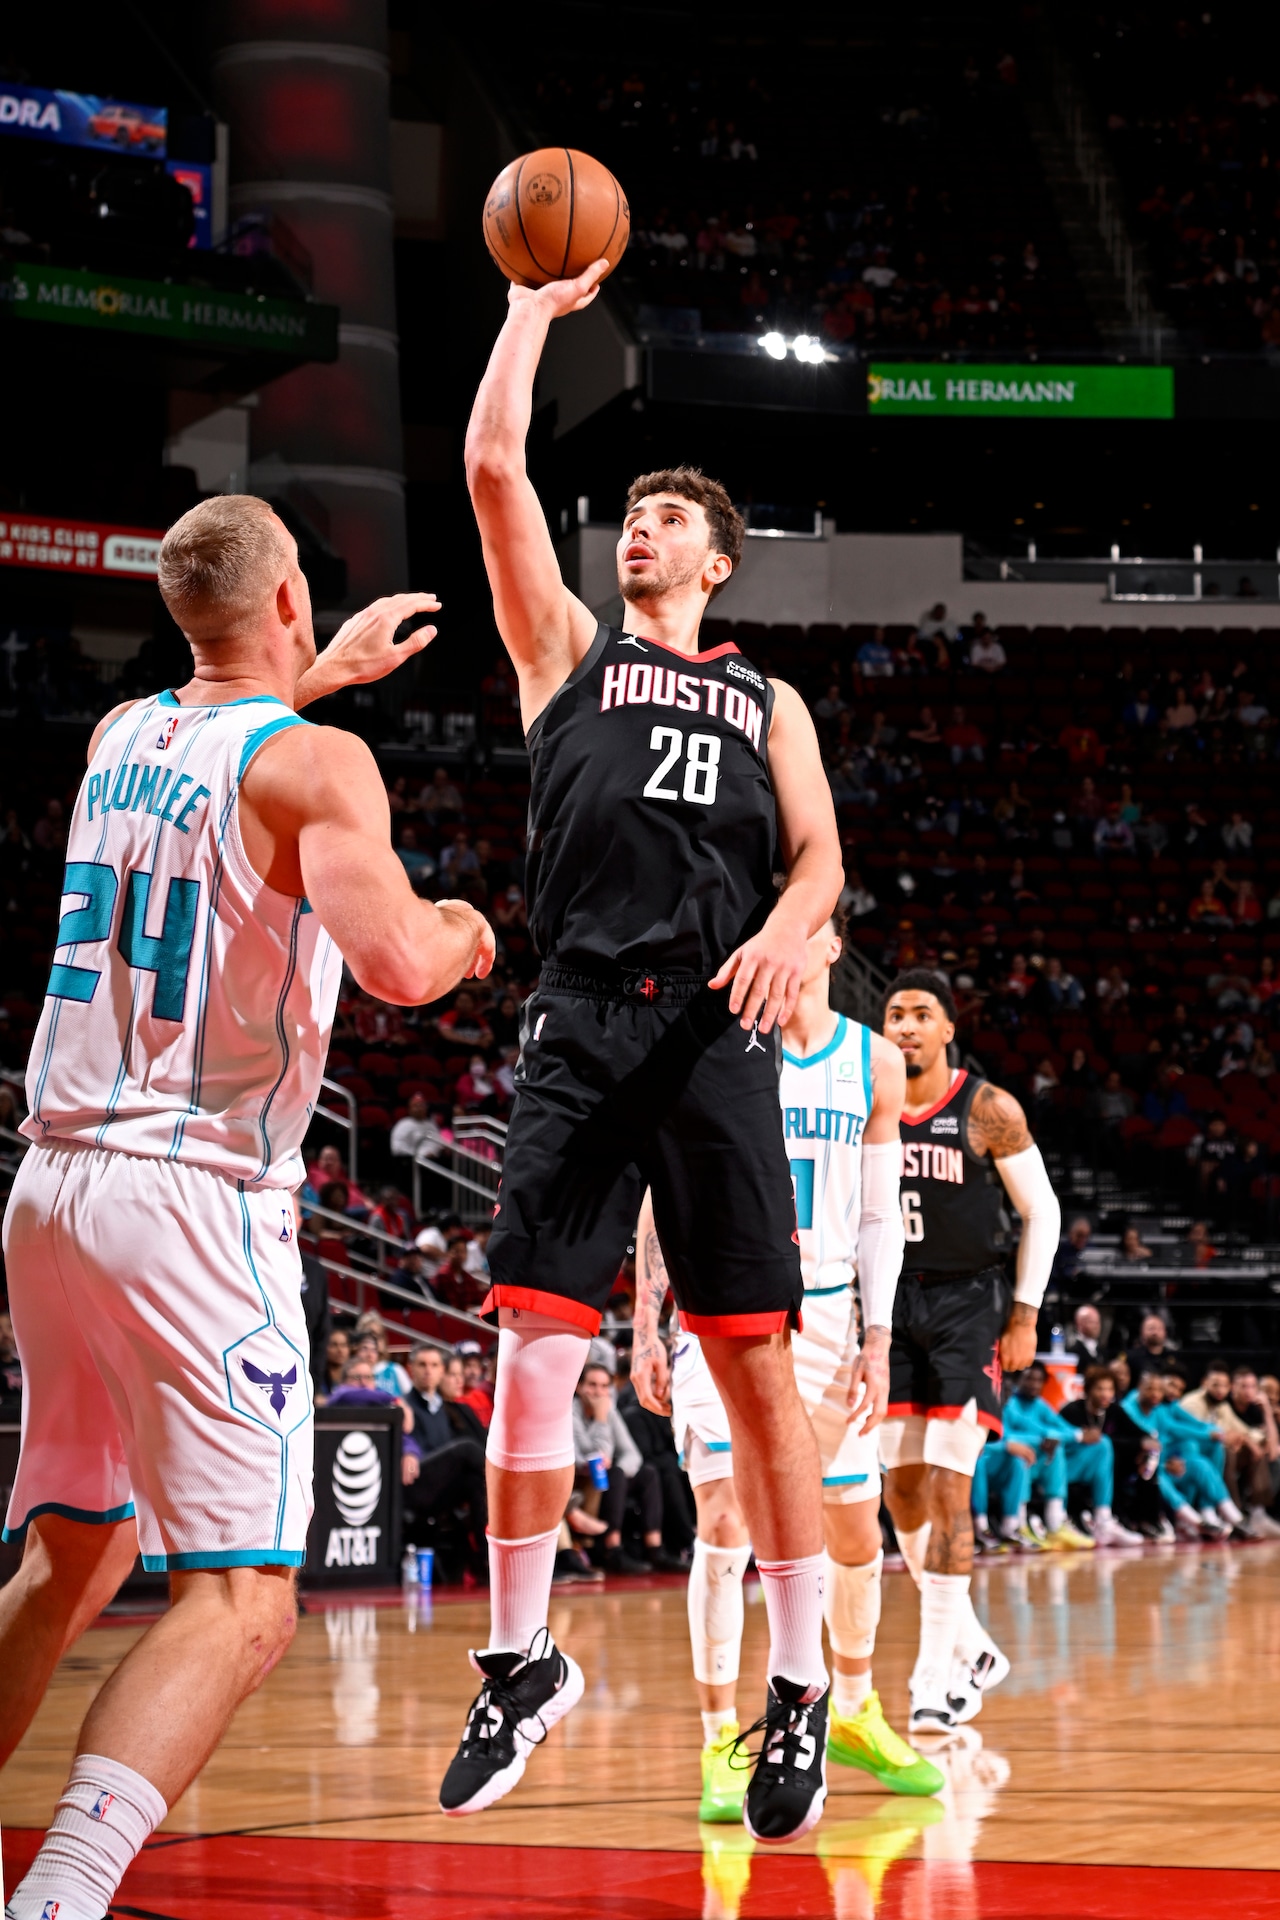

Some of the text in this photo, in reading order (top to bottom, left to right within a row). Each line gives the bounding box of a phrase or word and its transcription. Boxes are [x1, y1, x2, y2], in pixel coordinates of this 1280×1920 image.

[0, 95, 61, 132] DRA
[36, 282, 172, 320] MEMORIAL
[182, 301, 306, 336] HERMANN
[945, 379, 1075, 402] HERMANN
[726, 665, 765, 691] karma
[728, 660, 762, 682] credit
[600, 663, 764, 752] HOUSTON
[643, 725, 722, 806] 28
[88, 763, 212, 834] PLUMLEE
[46, 862, 201, 1023] 24
[901, 1190, 925, 1243] 6
[325, 1526, 381, 1567] AT&T
